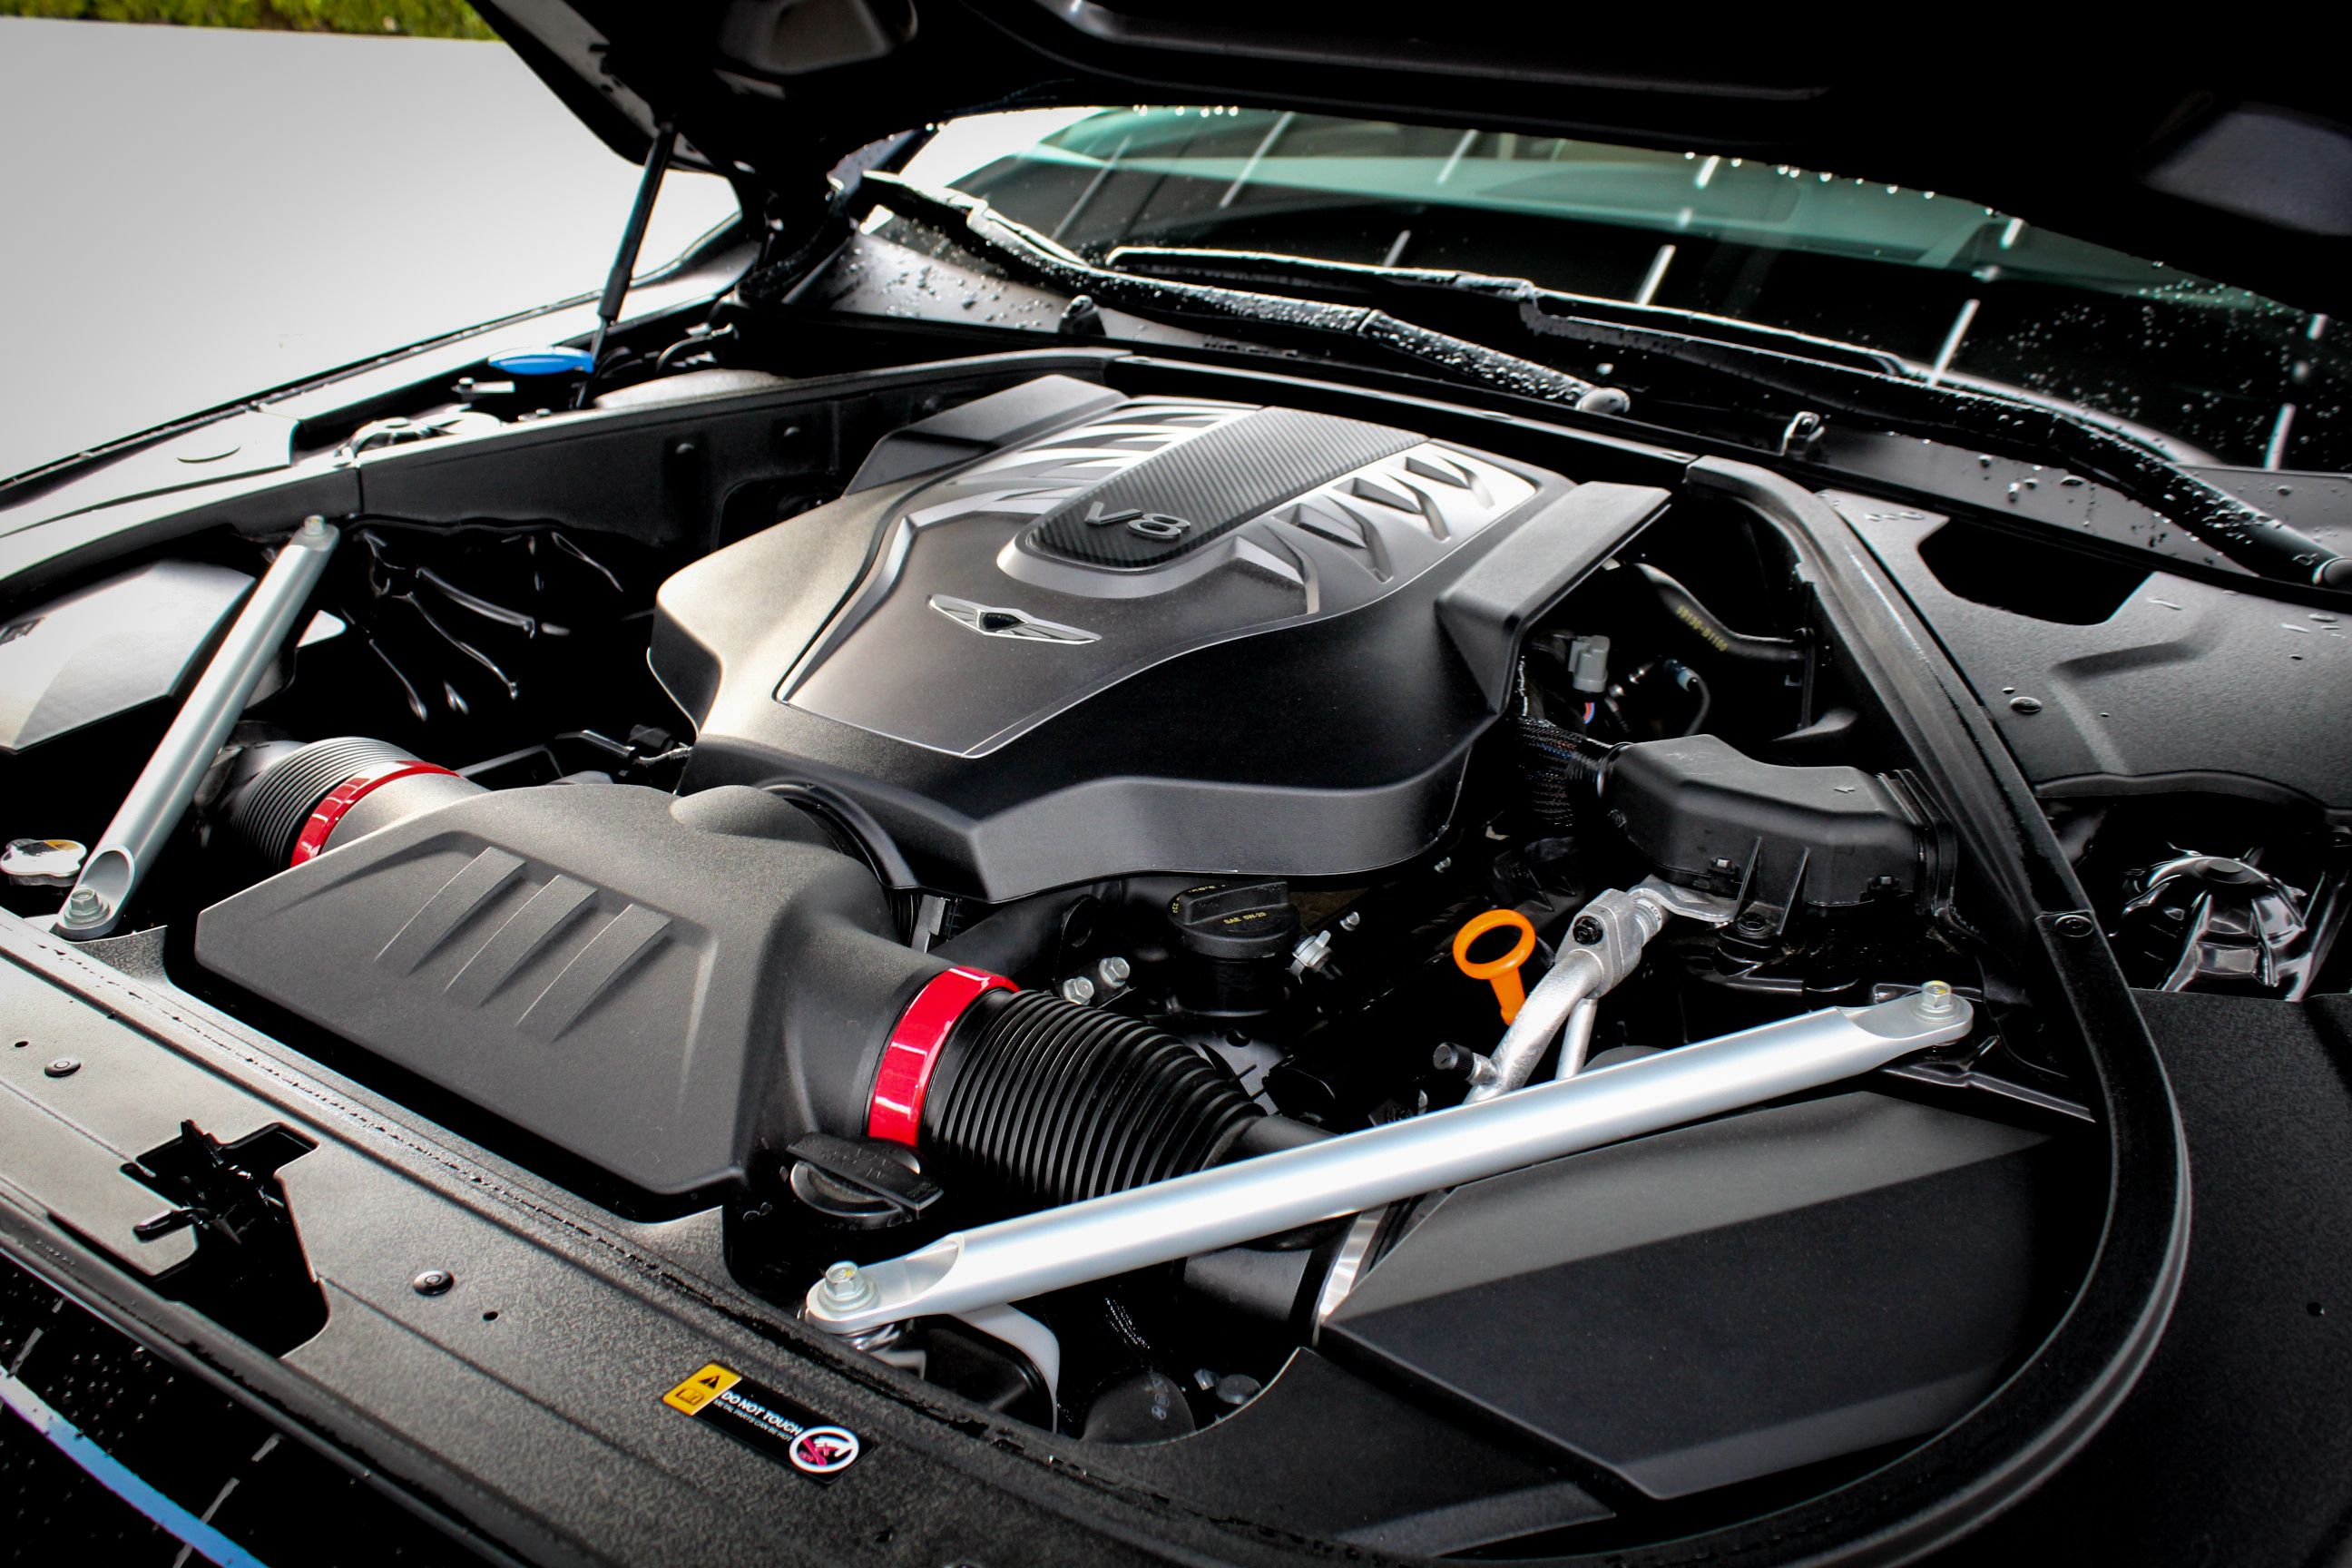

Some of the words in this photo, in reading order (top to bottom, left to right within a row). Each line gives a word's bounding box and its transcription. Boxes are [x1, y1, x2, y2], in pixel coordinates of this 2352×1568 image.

[1084, 501, 1191, 539] V8
[1223, 916, 1242, 925] SAE
[713, 1398, 735, 1413] METAL
[733, 1407, 756, 1424] PARTS
[753, 1417, 770, 1431] CAN
[767, 1425, 779, 1436] BE
[776, 1429, 794, 1442] HOT
[720, 1390, 741, 1405] DO
[738, 1398, 766, 1416] NOT
[763, 1409, 804, 1436] TOUCH
